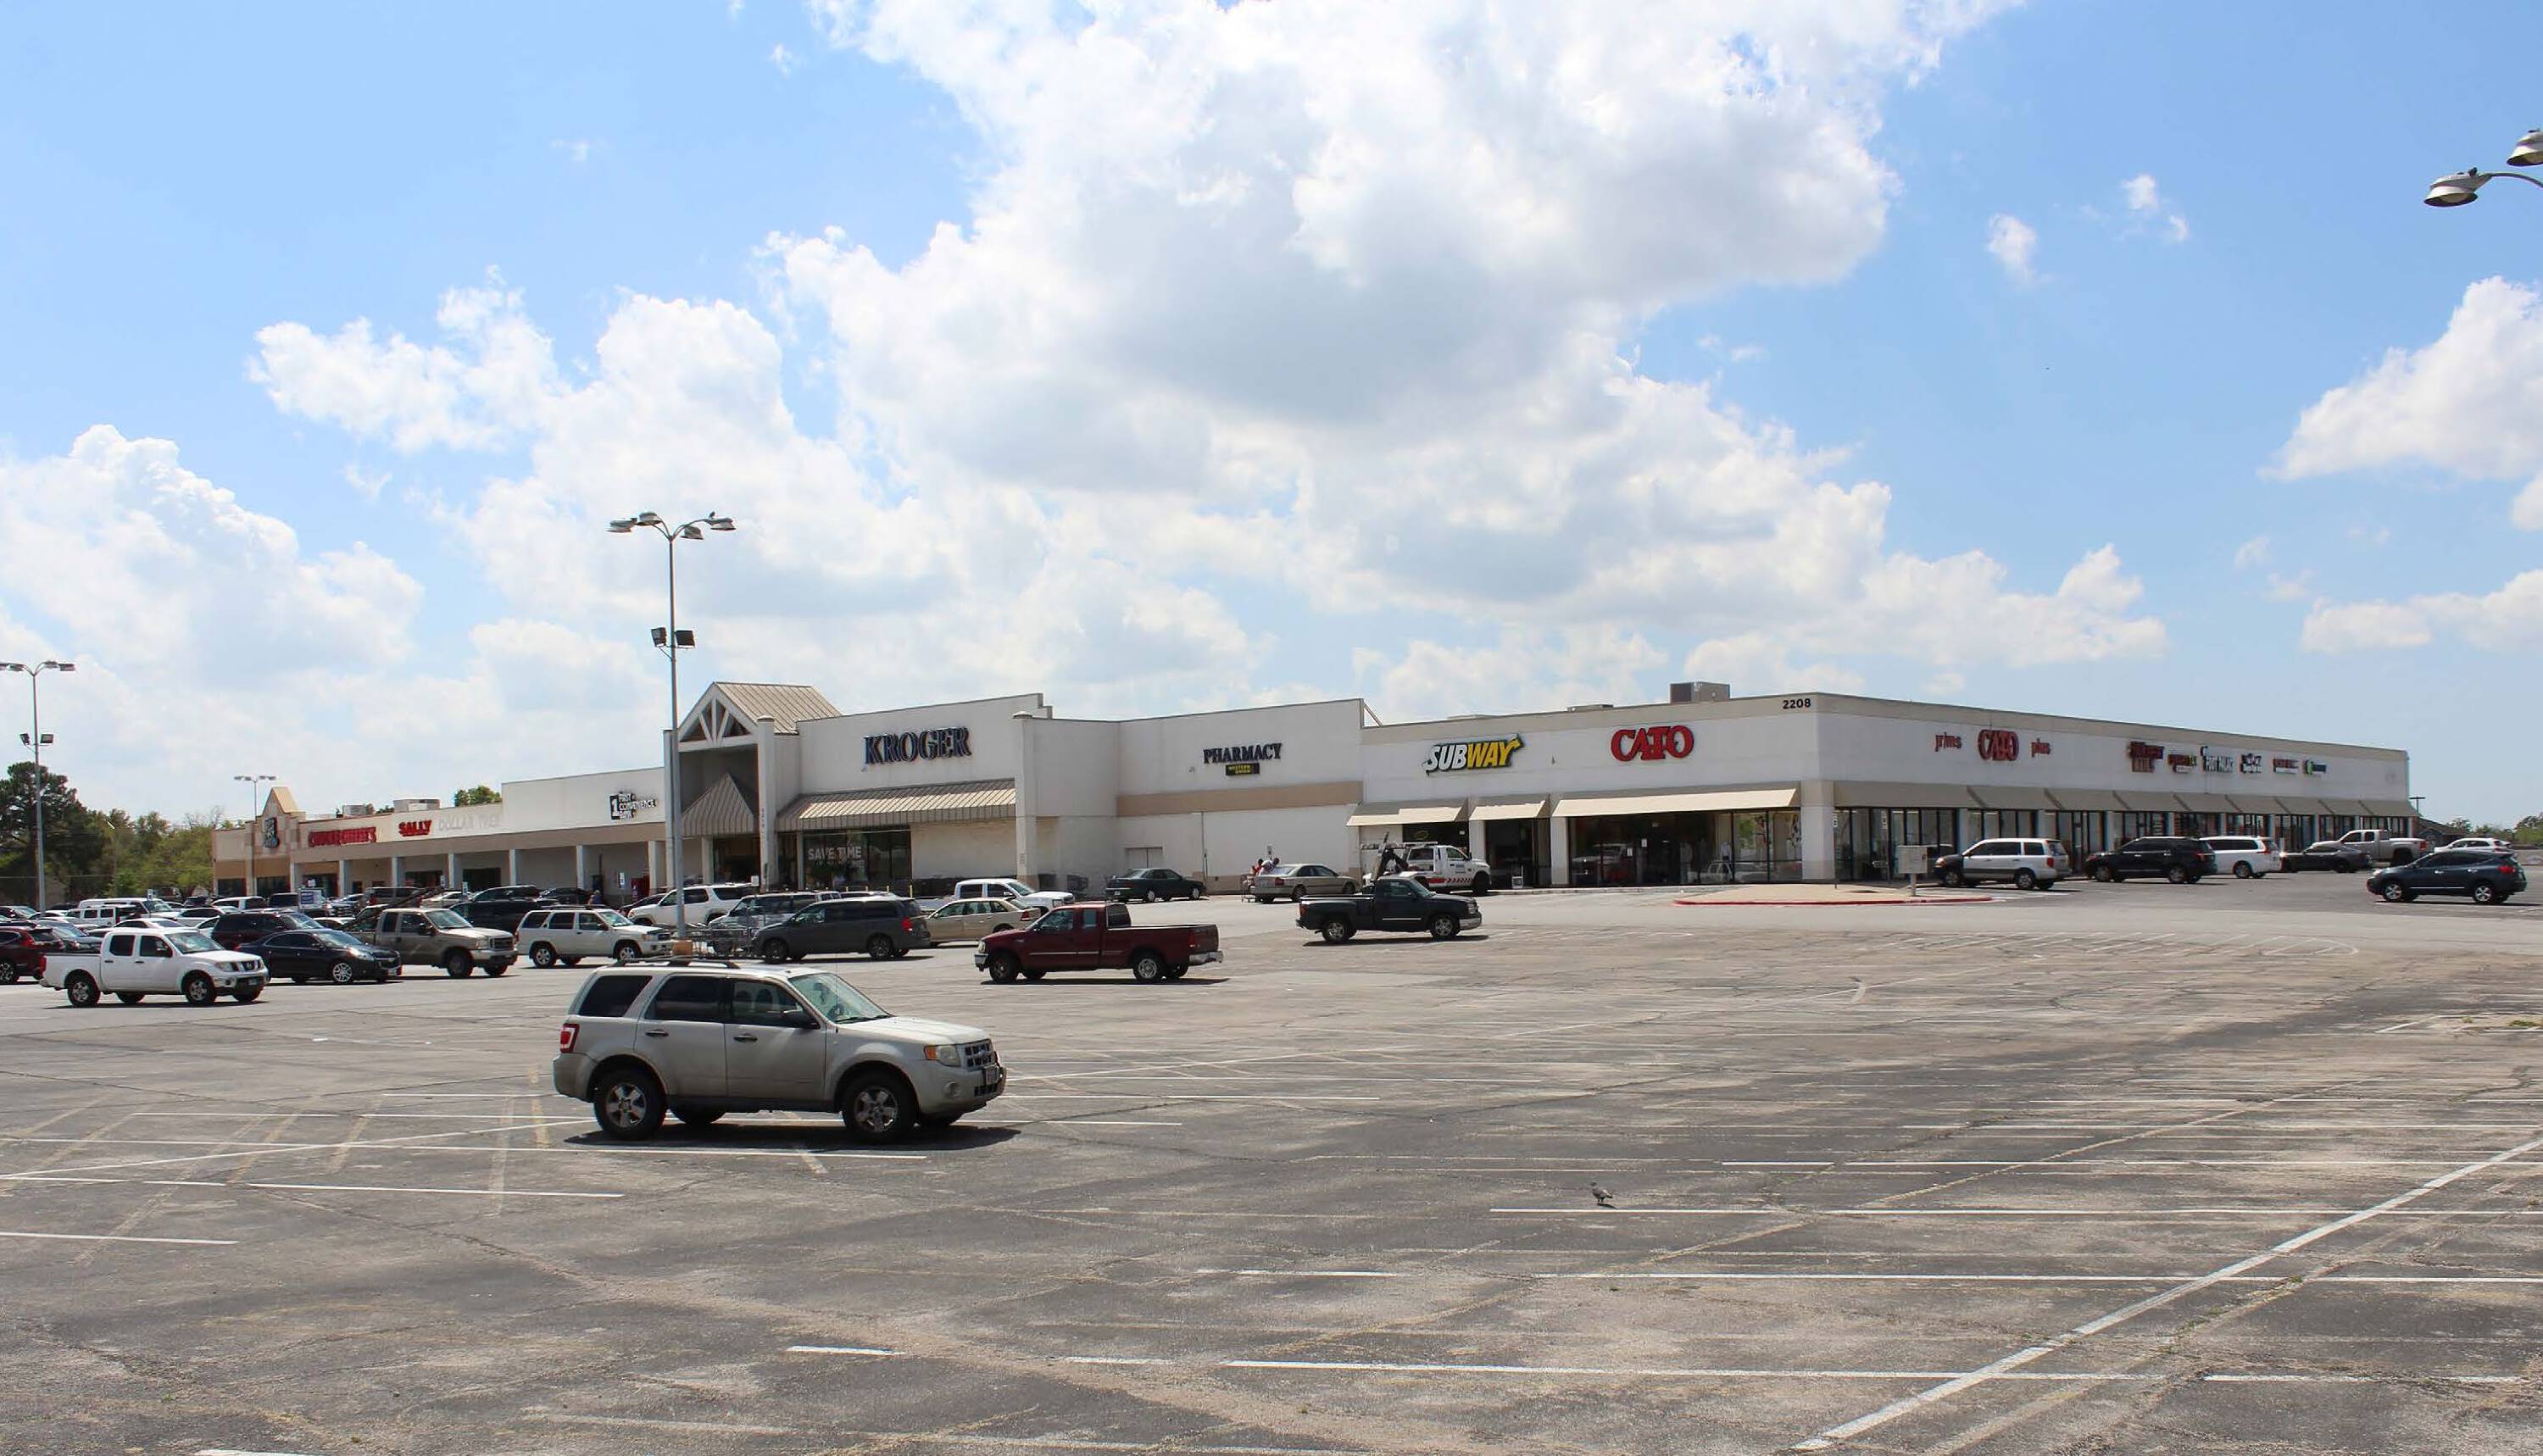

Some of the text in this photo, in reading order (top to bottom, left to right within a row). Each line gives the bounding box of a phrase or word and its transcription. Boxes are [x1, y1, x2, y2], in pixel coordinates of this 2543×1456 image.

[1782, 698, 1811, 709] 2208
[864, 727, 972, 764] KROGER
[1203, 742, 1283, 764] PHARMACY
[1424, 738, 1522, 771] SUBWAY
[1611, 725, 1694, 762] CATO
[1977, 729, 2019, 761] CATO
[398, 820, 432, 836] SALLY
[808, 847, 836, 861] SAVE
